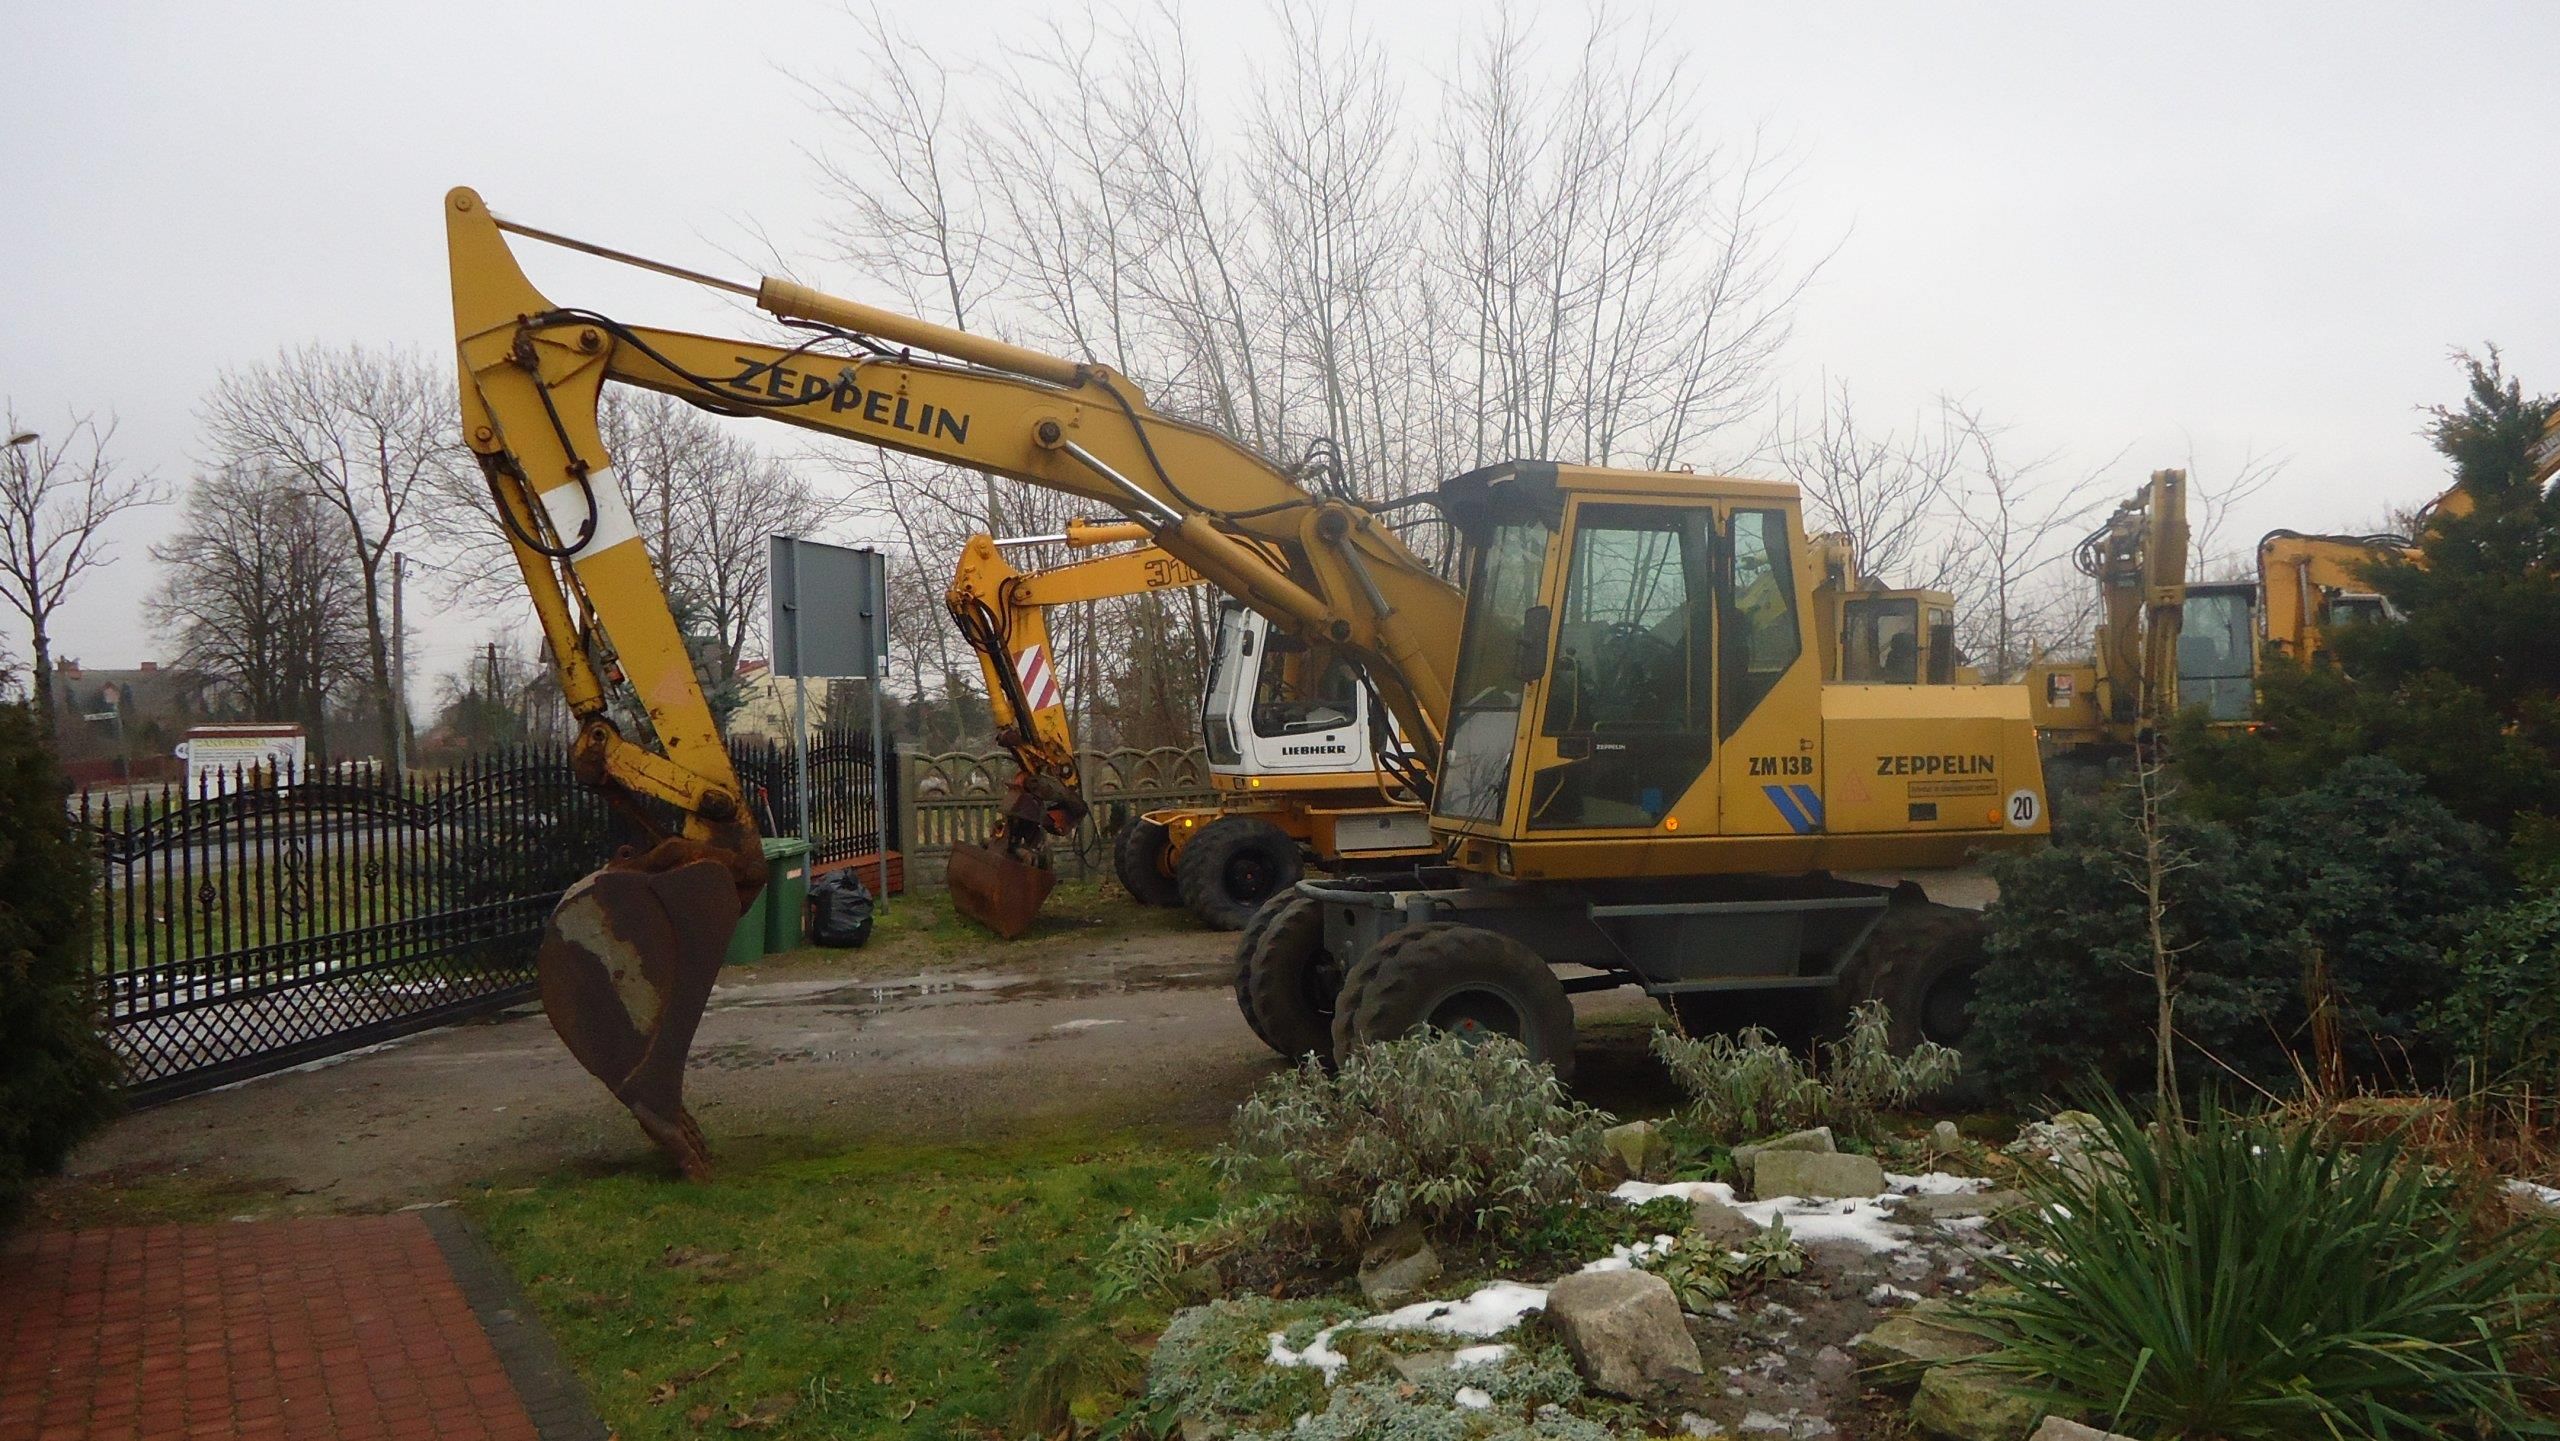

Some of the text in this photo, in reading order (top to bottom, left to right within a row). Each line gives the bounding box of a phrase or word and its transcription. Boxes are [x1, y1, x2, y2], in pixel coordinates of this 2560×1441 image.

[729, 356, 970, 445] ZEPPELIN
[1282, 745, 1346, 756] LIEBHERR
[1749, 756, 1813, 776] ZM 13B
[1876, 755, 1994, 776] ZEPPELIN
[2013, 796, 2033, 820] 20
